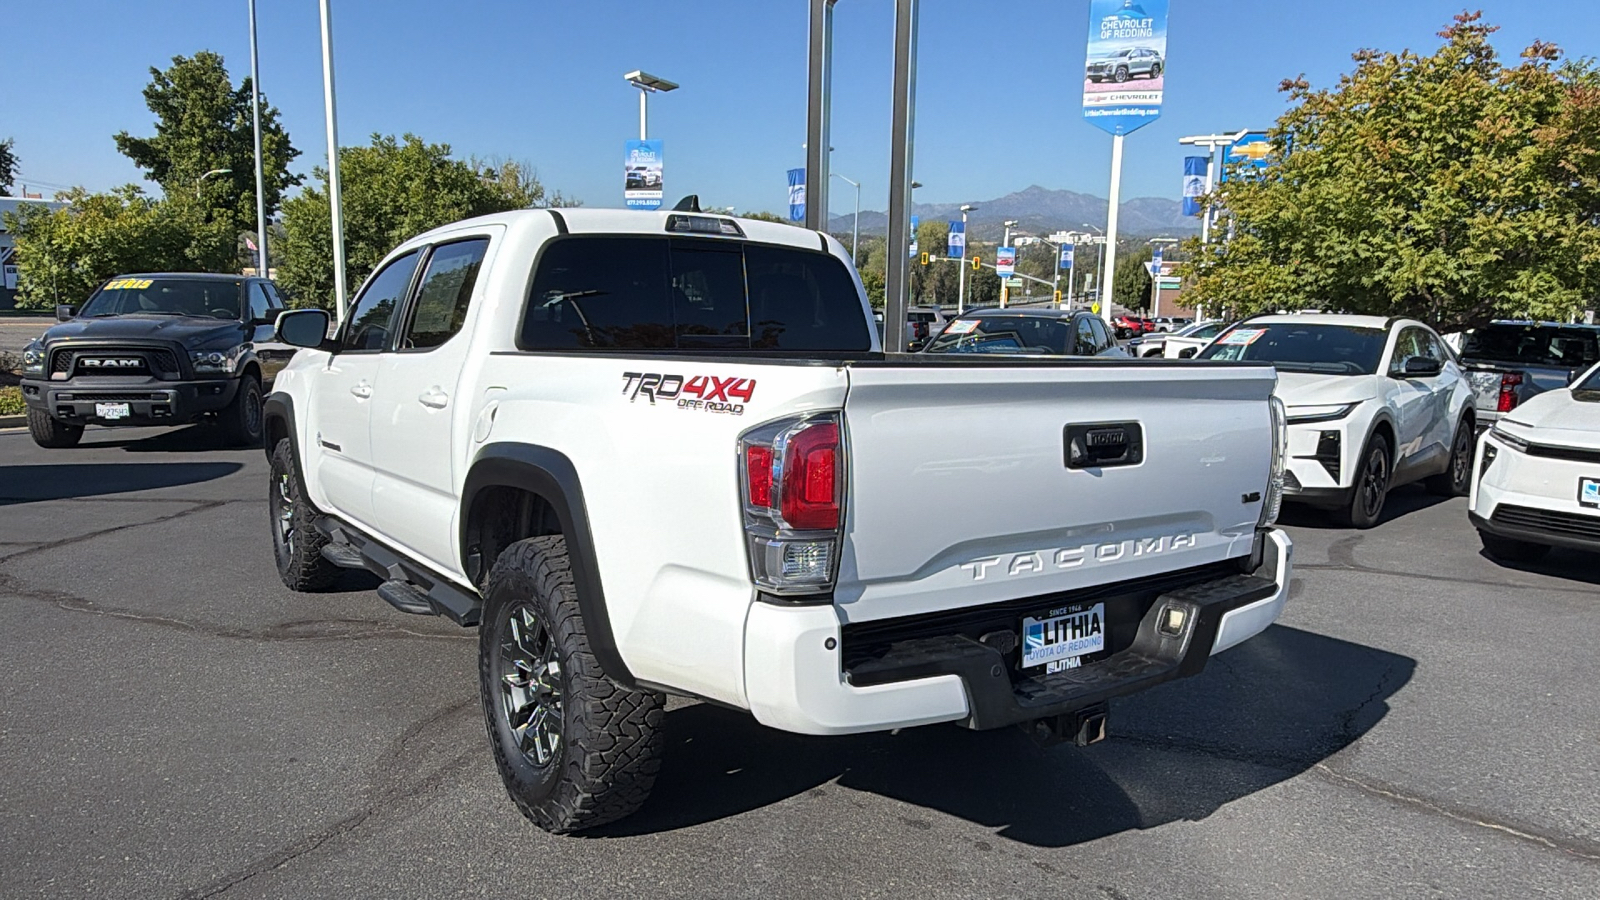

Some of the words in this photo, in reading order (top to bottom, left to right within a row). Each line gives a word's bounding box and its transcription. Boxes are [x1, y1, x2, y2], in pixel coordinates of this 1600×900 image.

[1101, 19, 1153, 30] CHEVROLET
[1101, 30, 1112, 39] OF
[1114, 28, 1152, 38] REDDING
[84, 359, 139, 367] RAM
[622, 371, 684, 405] TRD
[677, 399, 704, 411] OFF
[704, 401, 744, 416] ROAD
[961, 534, 1196, 581] TACOMA
[1049, 606, 1067, 617] SINCE
[1068, 604, 1082, 613] 1946
[1043, 612, 1102, 646] LITHIA
[1056, 643, 1067, 655] OF
[1068, 635, 1103, 652] REDDING
[1055, 656, 1082, 672] LITHIA
